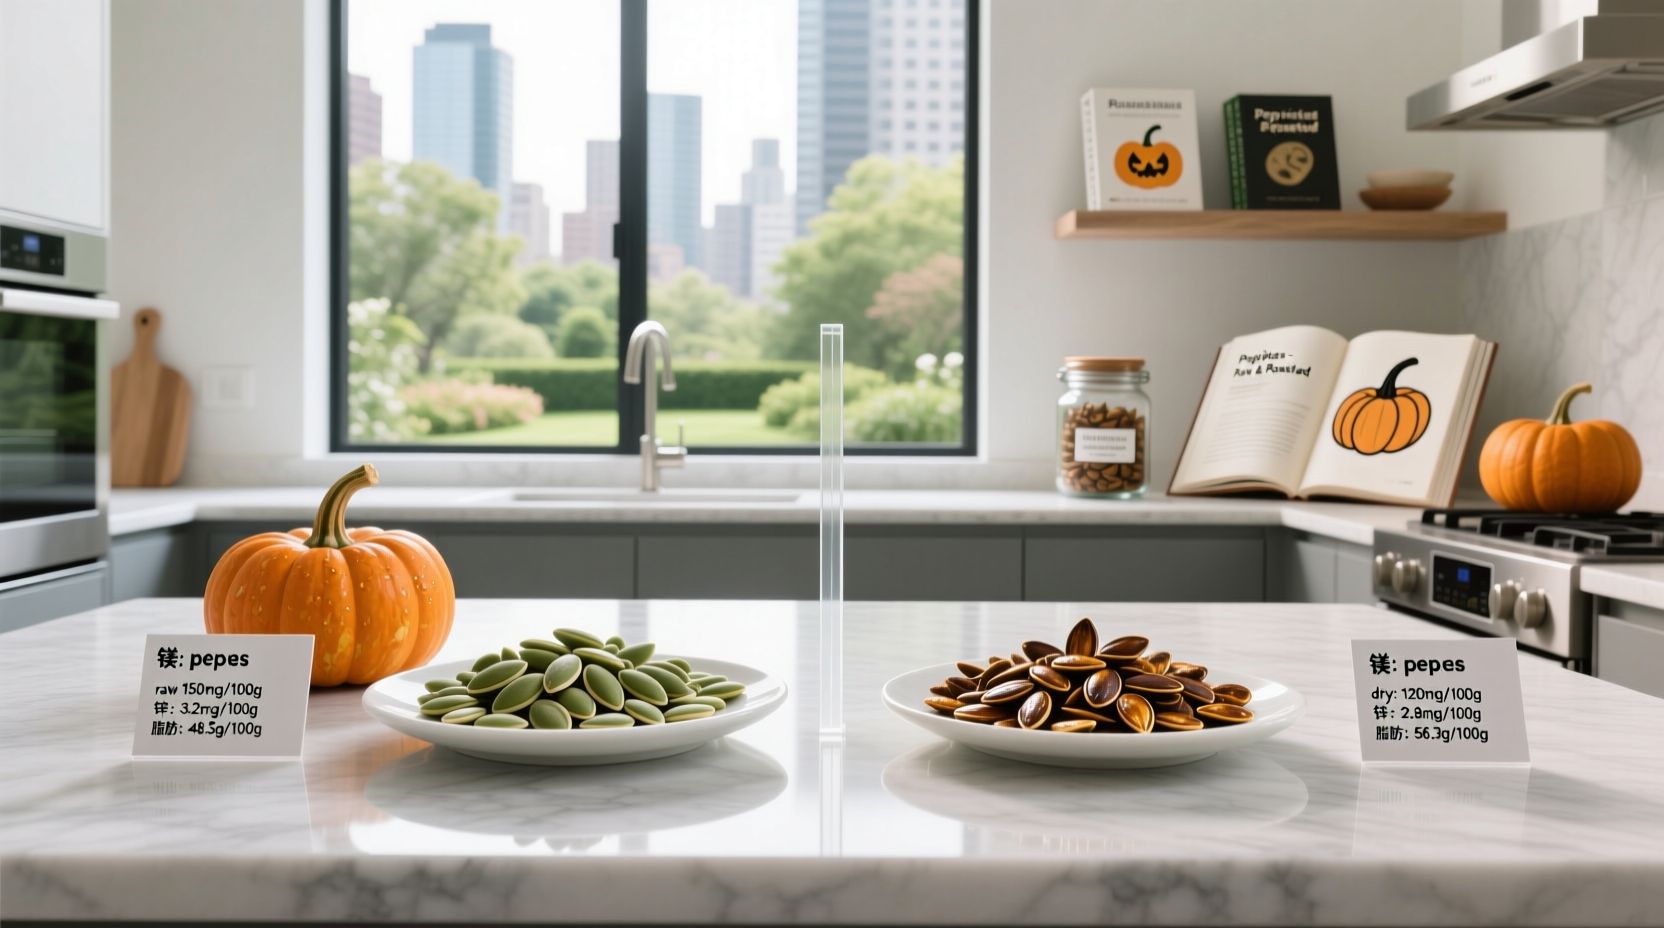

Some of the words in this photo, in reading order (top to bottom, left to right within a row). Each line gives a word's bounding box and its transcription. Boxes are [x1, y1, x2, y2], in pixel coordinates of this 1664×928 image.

[190, 654, 249, 671] pepes
[1404, 660, 1465, 676] pepes
[156, 686, 177, 695] raw
[1372, 687, 1396, 706] dry:
[180, 702, 258, 718] 3.2mg/100g
